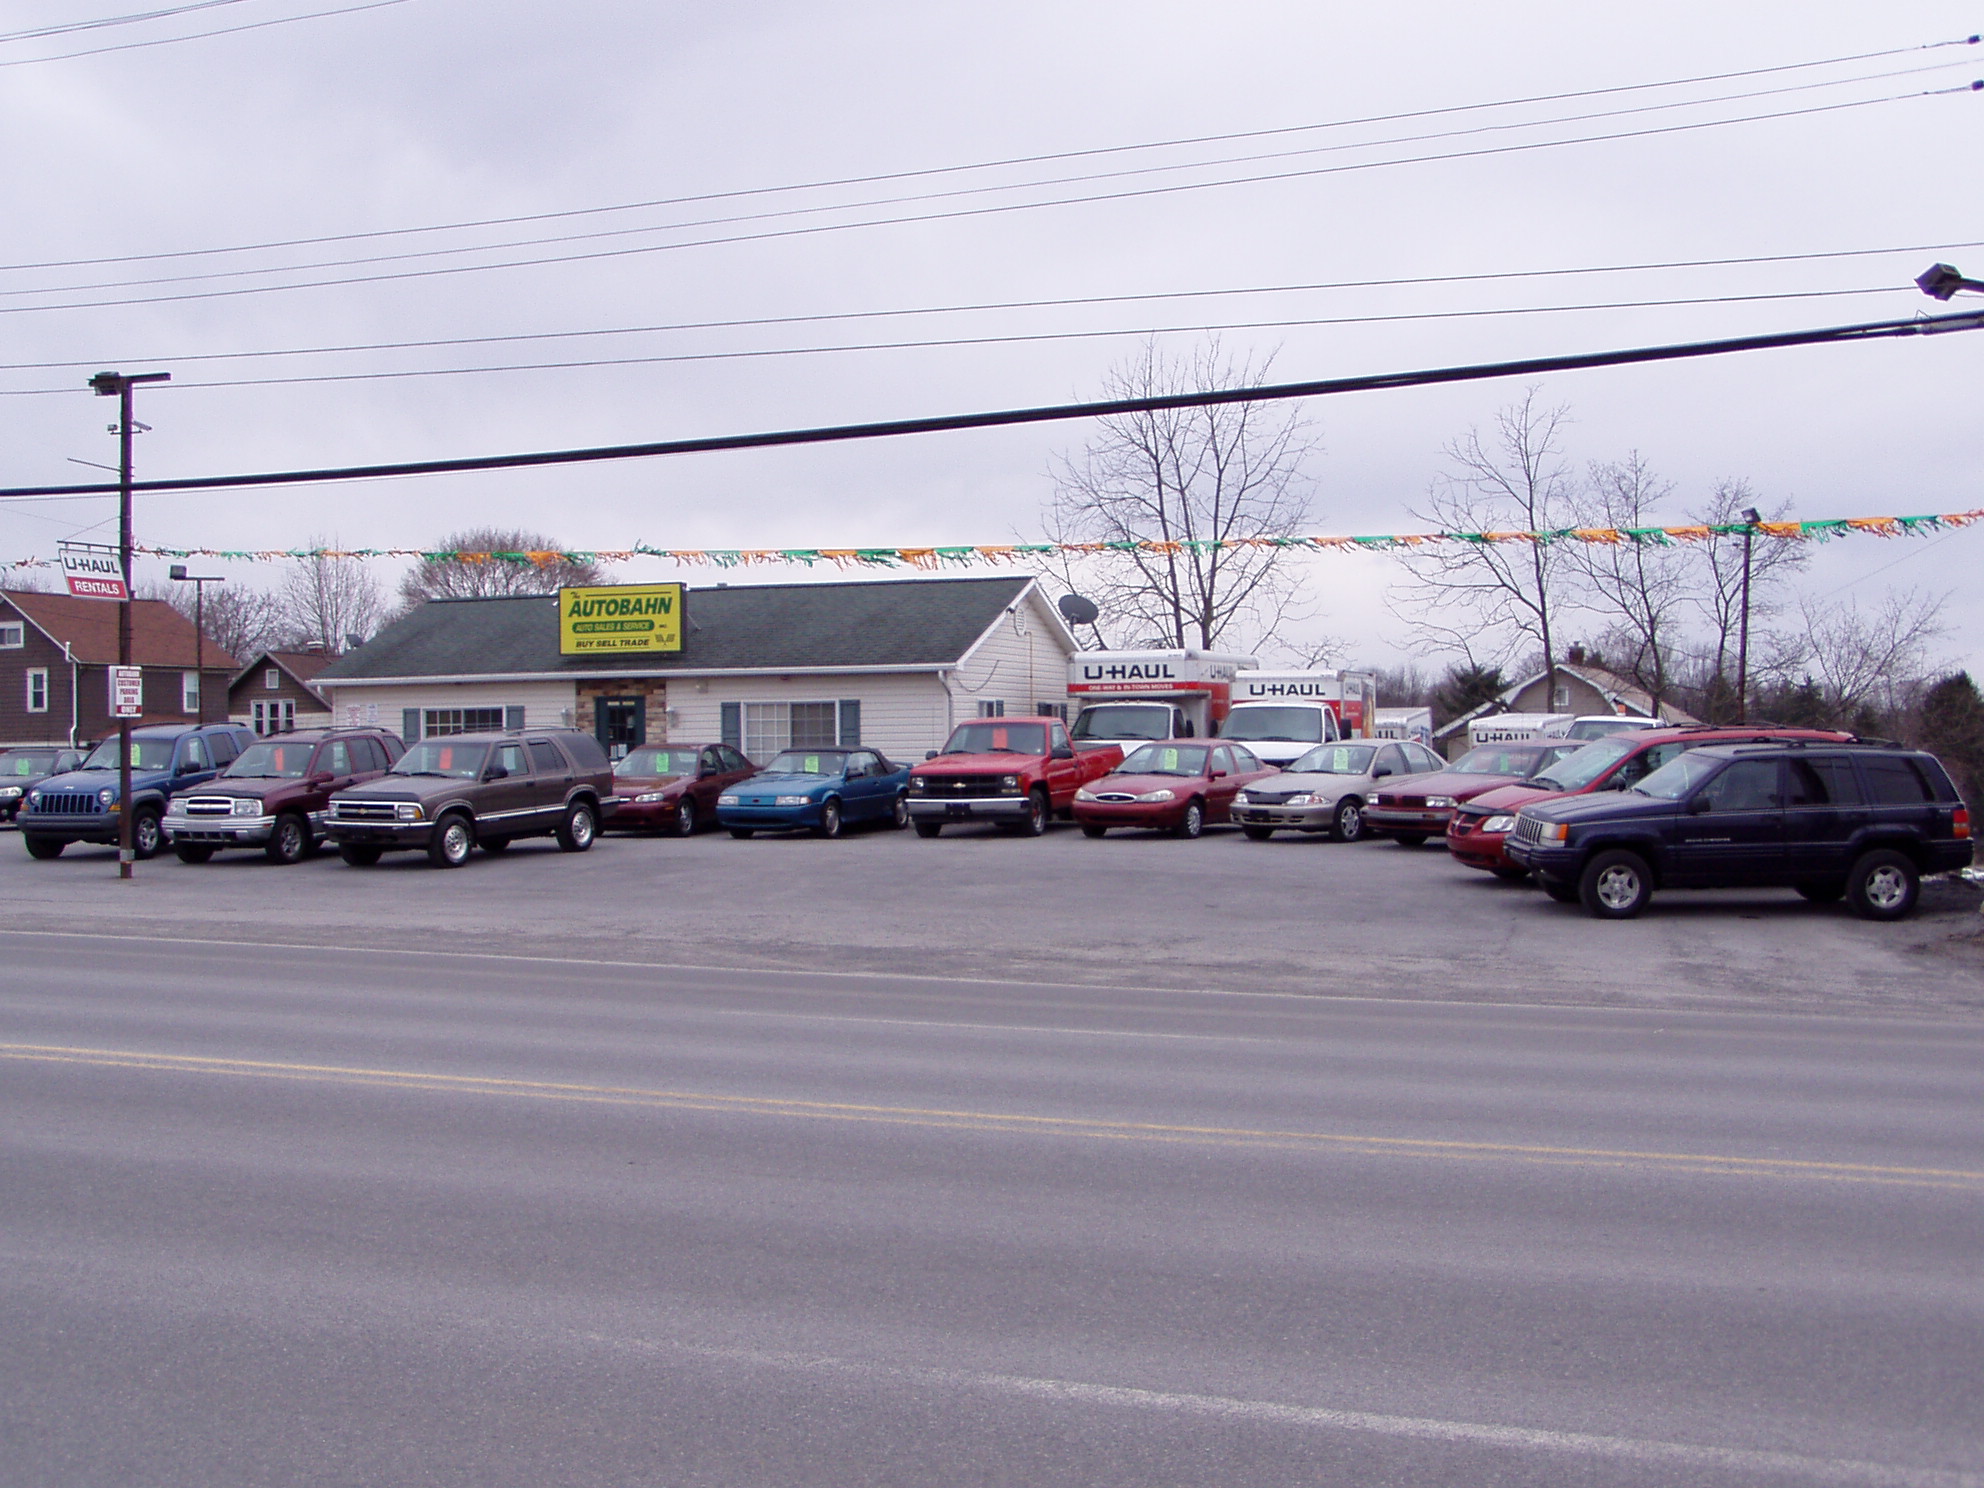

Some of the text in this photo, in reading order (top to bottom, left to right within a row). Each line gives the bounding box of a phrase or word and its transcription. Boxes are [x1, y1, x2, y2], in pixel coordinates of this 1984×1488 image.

[64, 557, 119, 574] U-HAUL
[74, 581, 120, 595] RENTALS
[568, 597, 672, 617] AUTOBAHN
[575, 621, 650, 632] AUTO SALES & SERVICE
[576, 640, 595, 648] BUY
[596, 639, 617, 647] SELL
[1084, 664, 1175, 679] U-HAUL
[1249, 684, 1326, 696] U-HAUL
